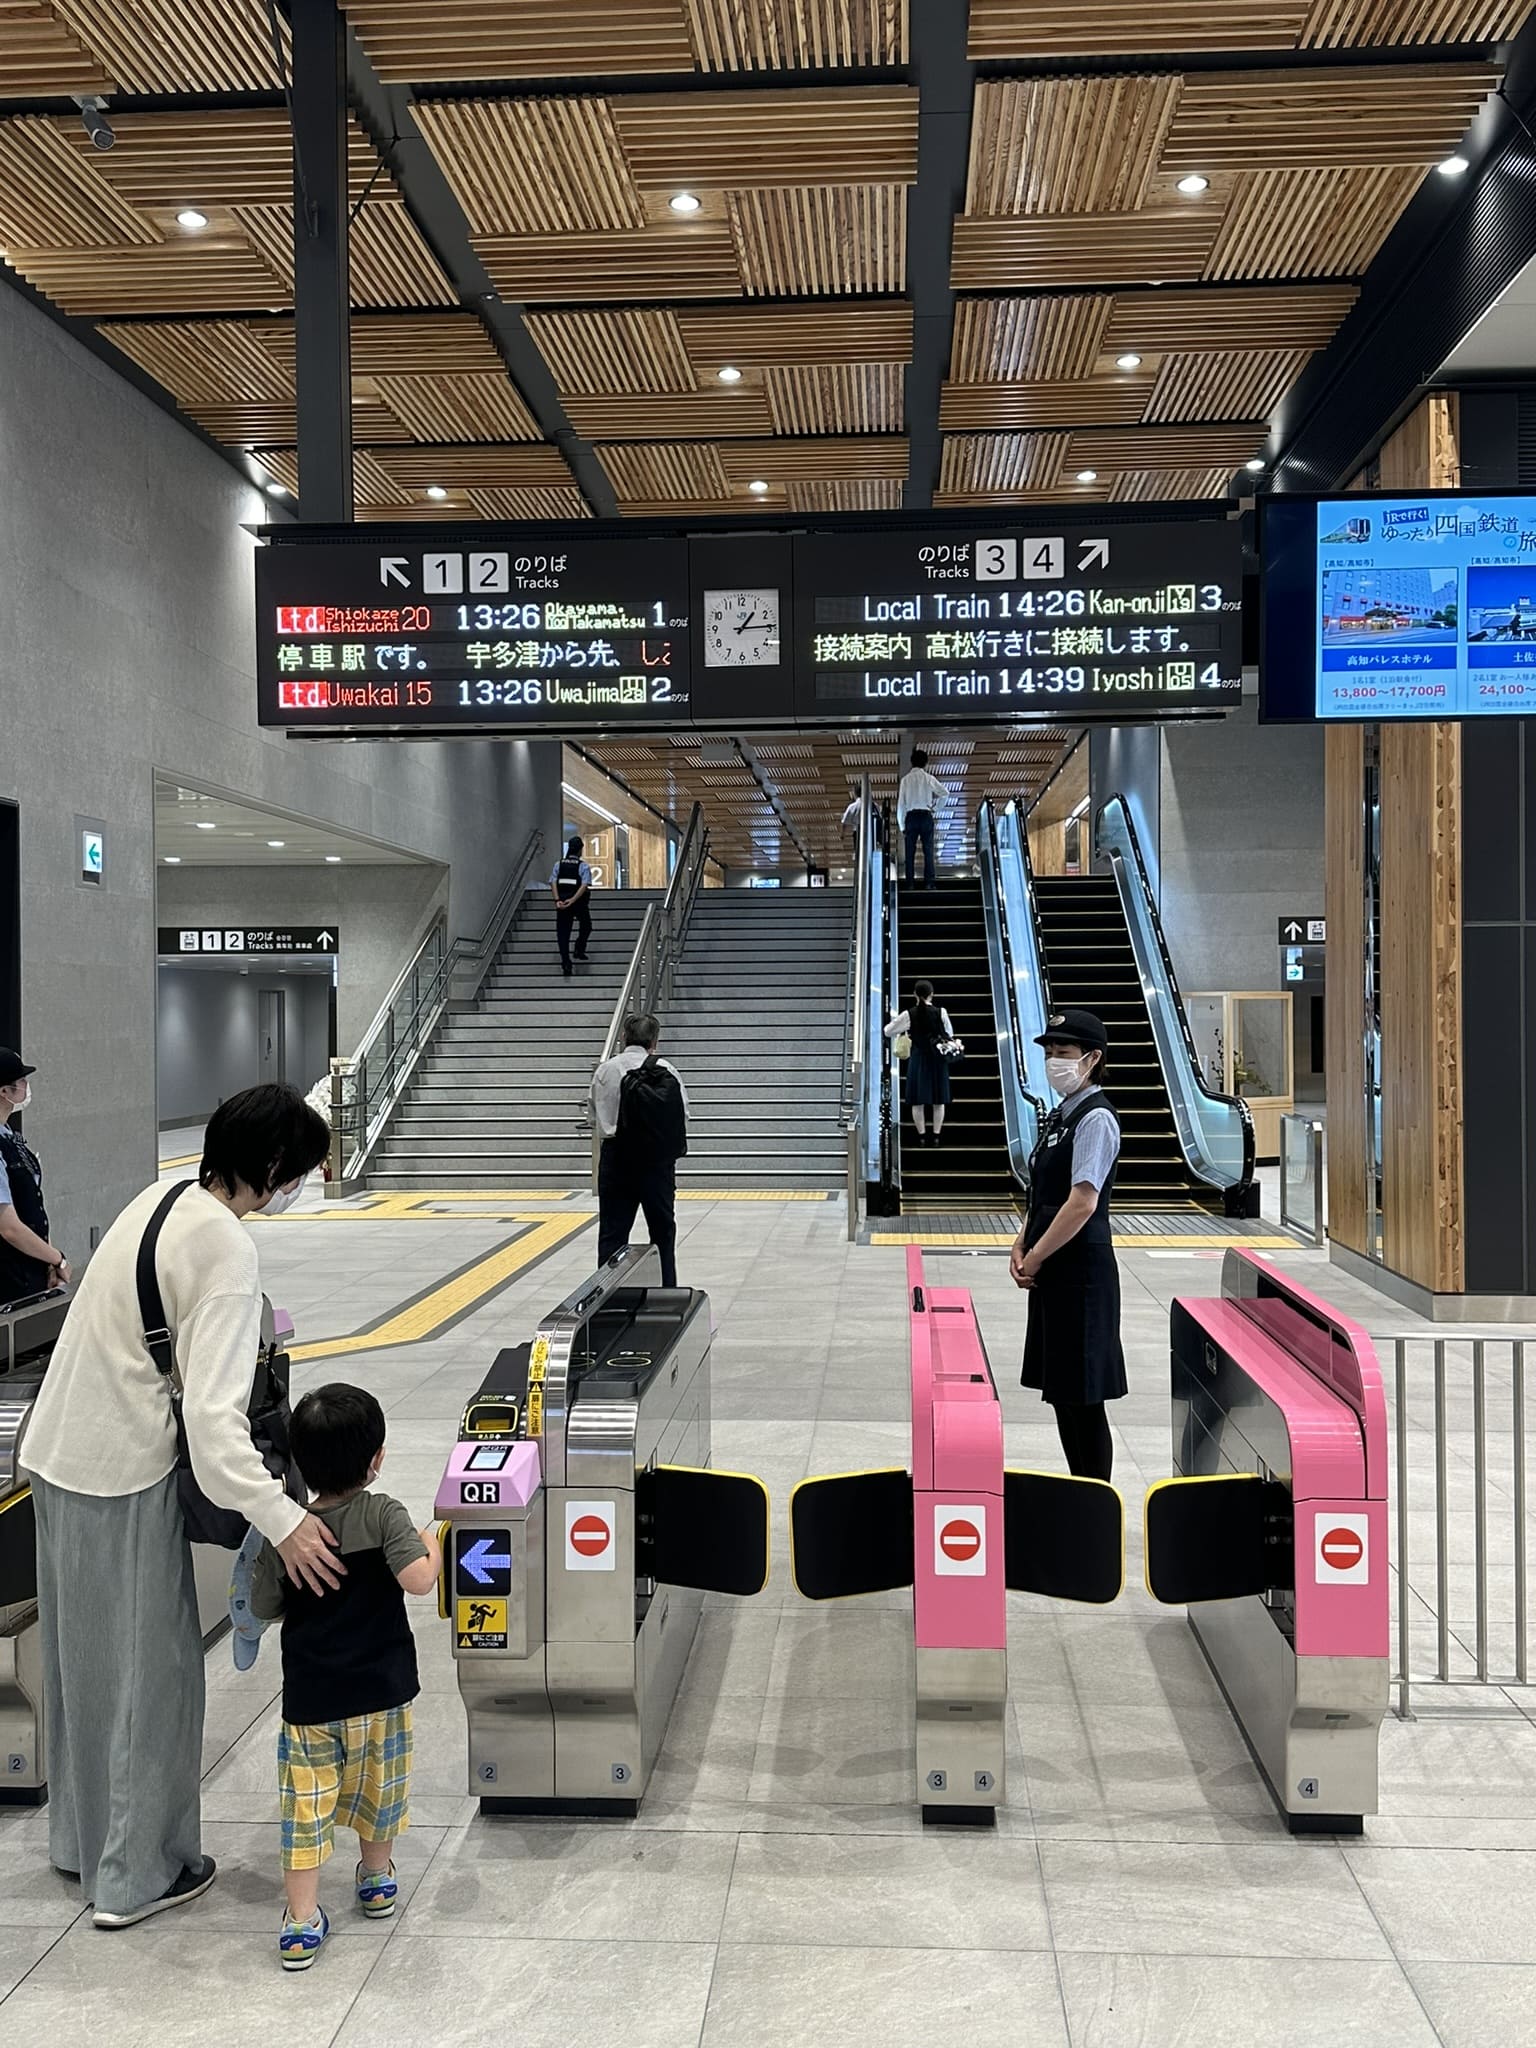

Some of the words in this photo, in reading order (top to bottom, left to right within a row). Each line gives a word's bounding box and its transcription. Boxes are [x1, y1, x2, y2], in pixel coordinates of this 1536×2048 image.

[918, 544, 970, 562] のりば
[986, 545, 1005, 575] 3
[1032, 543, 1054, 573] 4
[435, 559, 447, 588] 1
[479, 557, 499, 587] 2
[514, 554, 568, 573] のりば
[925, 565, 970, 579] Tracks
[515, 576, 560, 589] Tracks
[723, 598, 732, 610] 11
[737, 597, 746, 607] 12
[864, 595, 921, 622] Local
[933, 593, 990, 620] Train
[999, 588, 1085, 618] 14:26
[1089, 589, 1165, 615] Kan-onji
[1199, 584, 1222, 611] 3
[276, 606, 325, 633] Ltd.
[326, 607, 400, 620] Shiokaze
[401, 606, 431, 631] 20
[457, 603, 541, 630] 13:26
[653, 600, 666, 627] 1
[714, 611, 723, 621] 10
[762, 610, 769, 620] 2
[326, 620, 400, 633] Ishizuchi
[570, 615, 646, 629] Takamatsu
[711, 624, 719, 634] 9
[716, 638, 722, 648] 8
[813, 631, 912, 662] 接続案内
[925, 625, 1190, 659] 高松行きに接続します。
[466, 639, 621, 669] 宇多津から先、
[725, 648, 732, 657] 7
[739, 651, 746, 661] 6
[753, 647, 760, 657] 5
[1347, 654, 1433, 666] 高知パレスホテル
[864, 670, 921, 697] Local
[933, 669, 990, 696] Train
[999, 666, 1085, 694] 14:39
[1199, 662, 1222, 688] 4
[278, 681, 328, 708] Ltd.
[328, 682, 399, 706] Uwakai
[406, 681, 432, 706] 15
[458, 678, 542, 705] 13:26
[545, 678, 620, 705] Uwajima
[650, 675, 672, 702] 2
[590, 837, 600, 856] 1
[590, 866, 604, 886] 2
[207, 934, 215, 948] 1
[229, 933, 240, 948] 2
[247, 931, 274, 941] のりば
[247, 941, 274, 950] Tracks
[463, 1483, 497, 1503] QR
[12, 1758, 21, 1770] 2
[485, 1766, 494, 1779] 2
[615, 1767, 625, 1780] 3
[933, 1774, 943, 1787] 3
[978, 1775, 988, 1787] 4
[1305, 1782, 1314, 1794] 4
